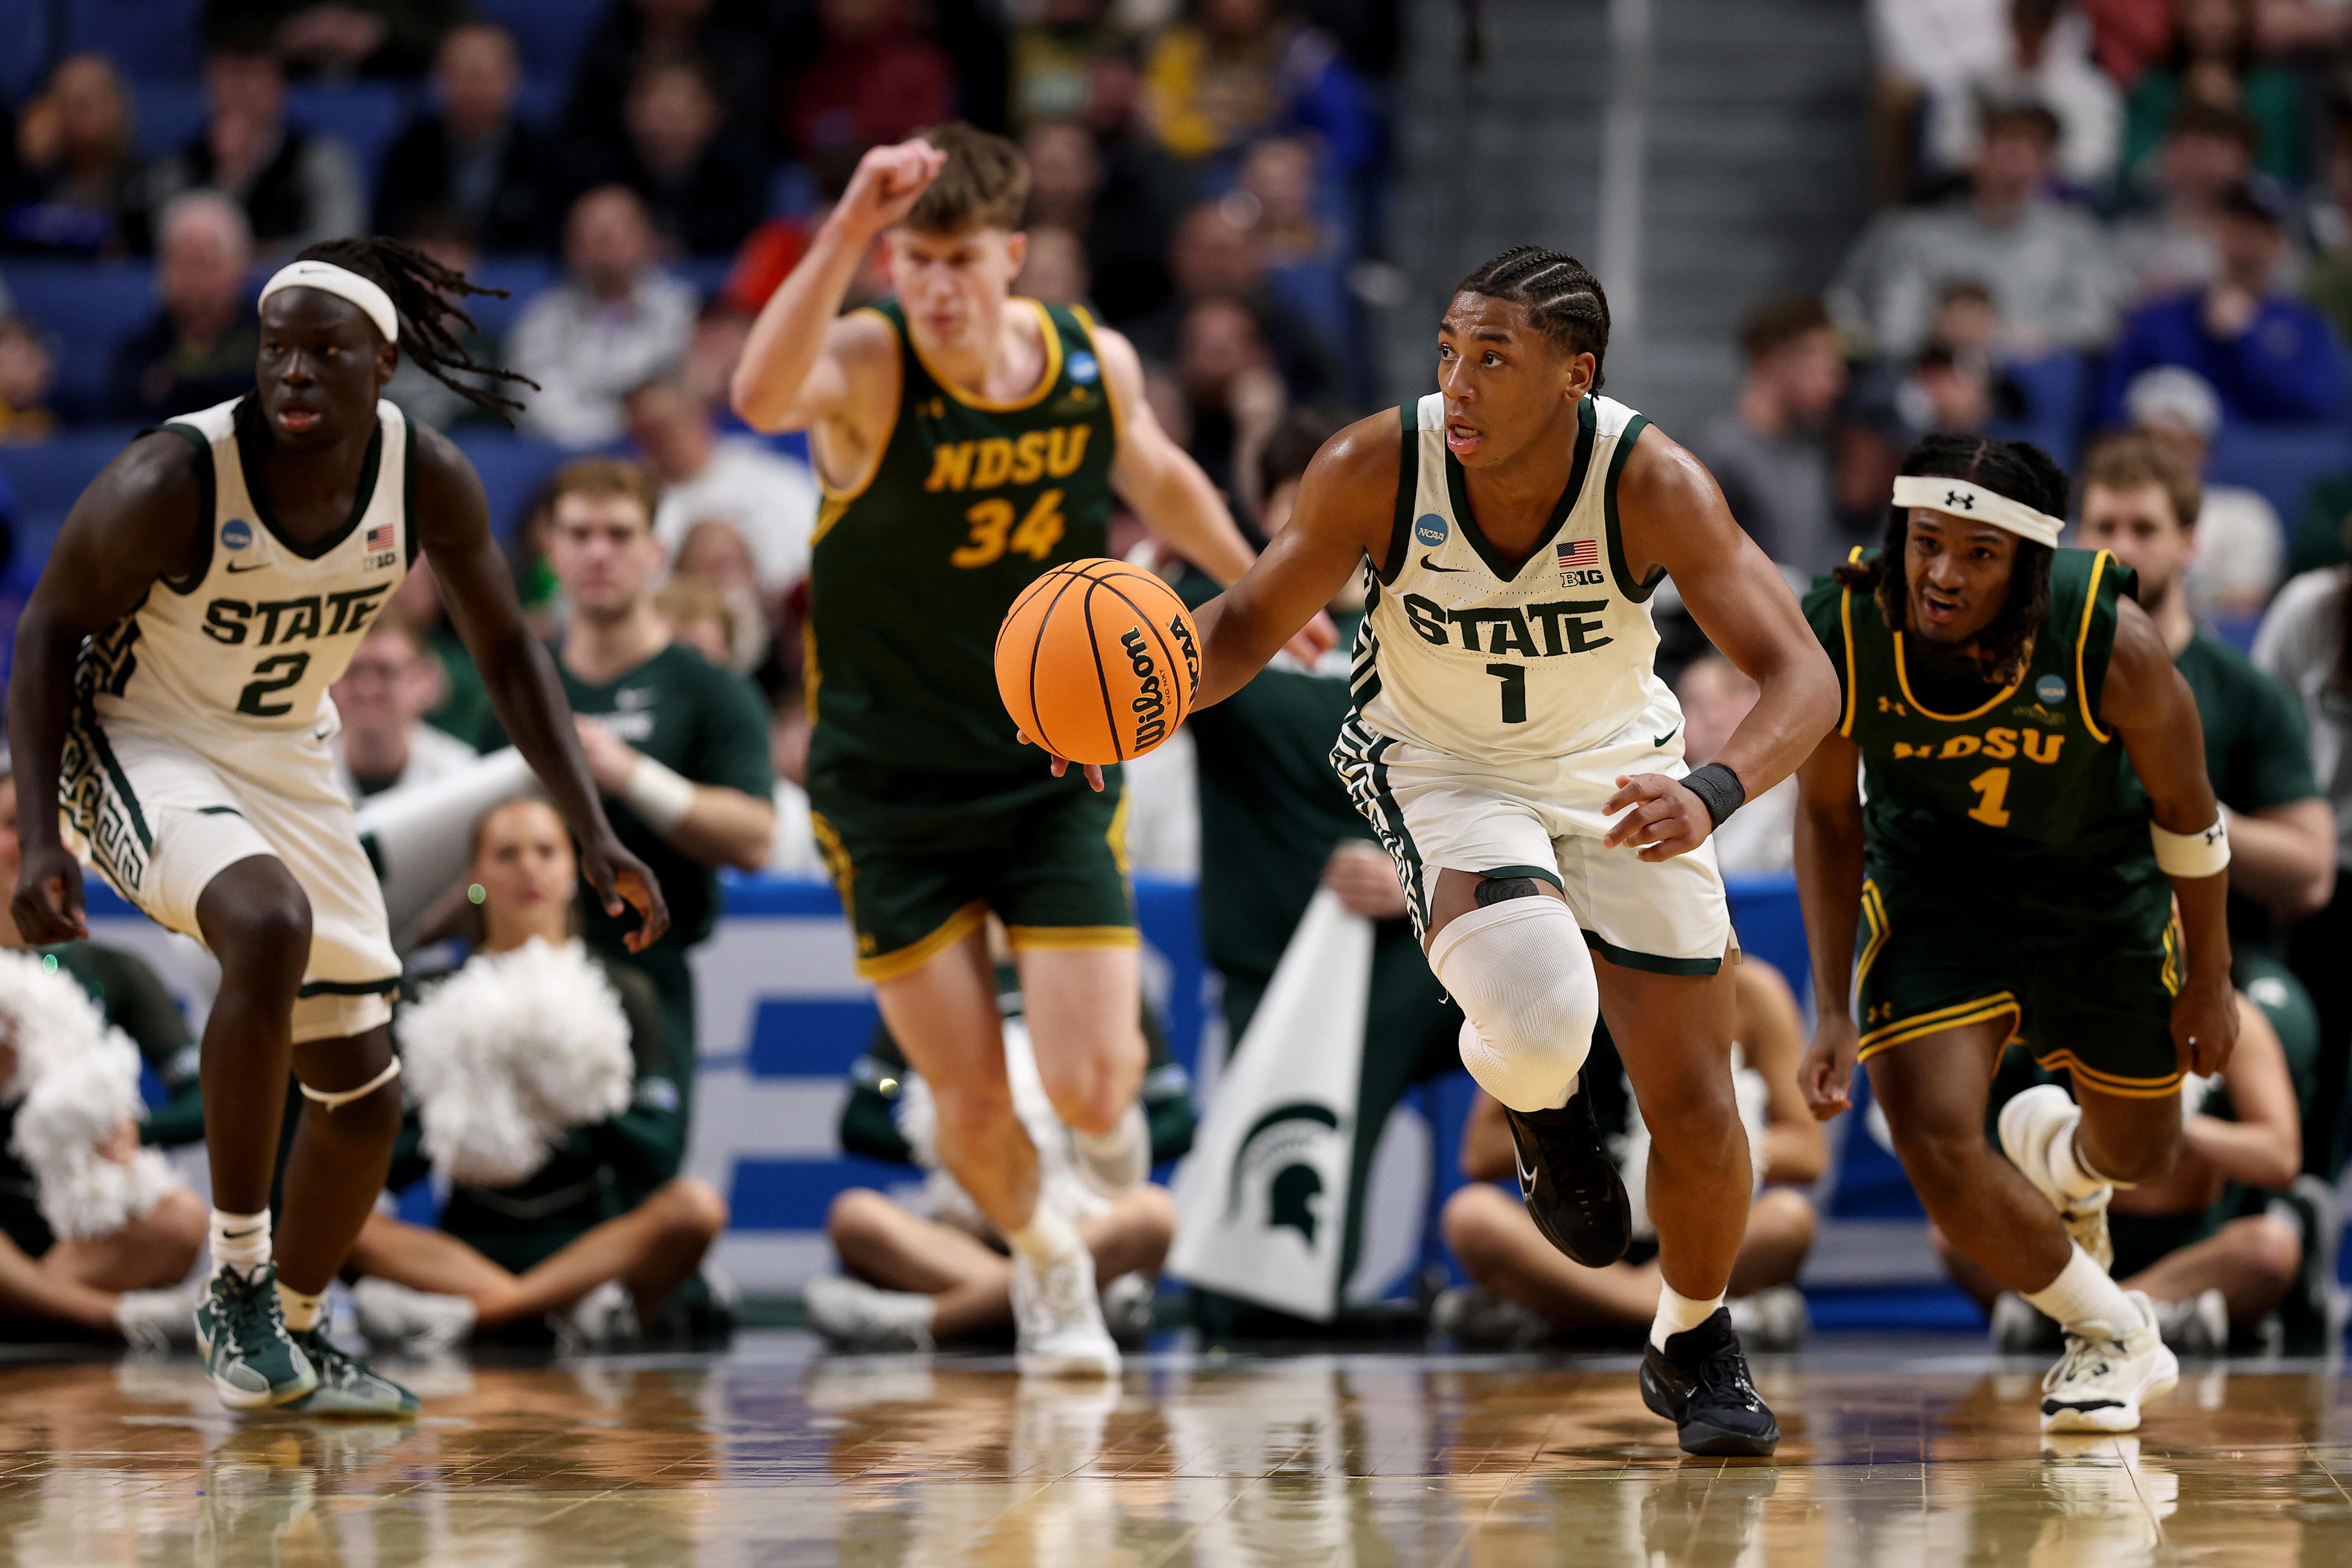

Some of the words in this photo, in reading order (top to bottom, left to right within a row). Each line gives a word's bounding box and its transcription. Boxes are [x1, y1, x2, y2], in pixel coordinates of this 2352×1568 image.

[924, 423, 1092, 493] NDSU
[950, 488, 1066, 569] 34
[1418, 527, 1445, 541] NCAA
[202, 580, 393, 648] STATE
[1403, 593, 1614, 657] STATE
[235, 651, 311, 716] 2
[1121, 625, 1166, 753] Wilson
[1159, 669, 1168, 687] NXT
[1486, 663, 1527, 723] 1
[1967, 767, 2011, 828] 1
